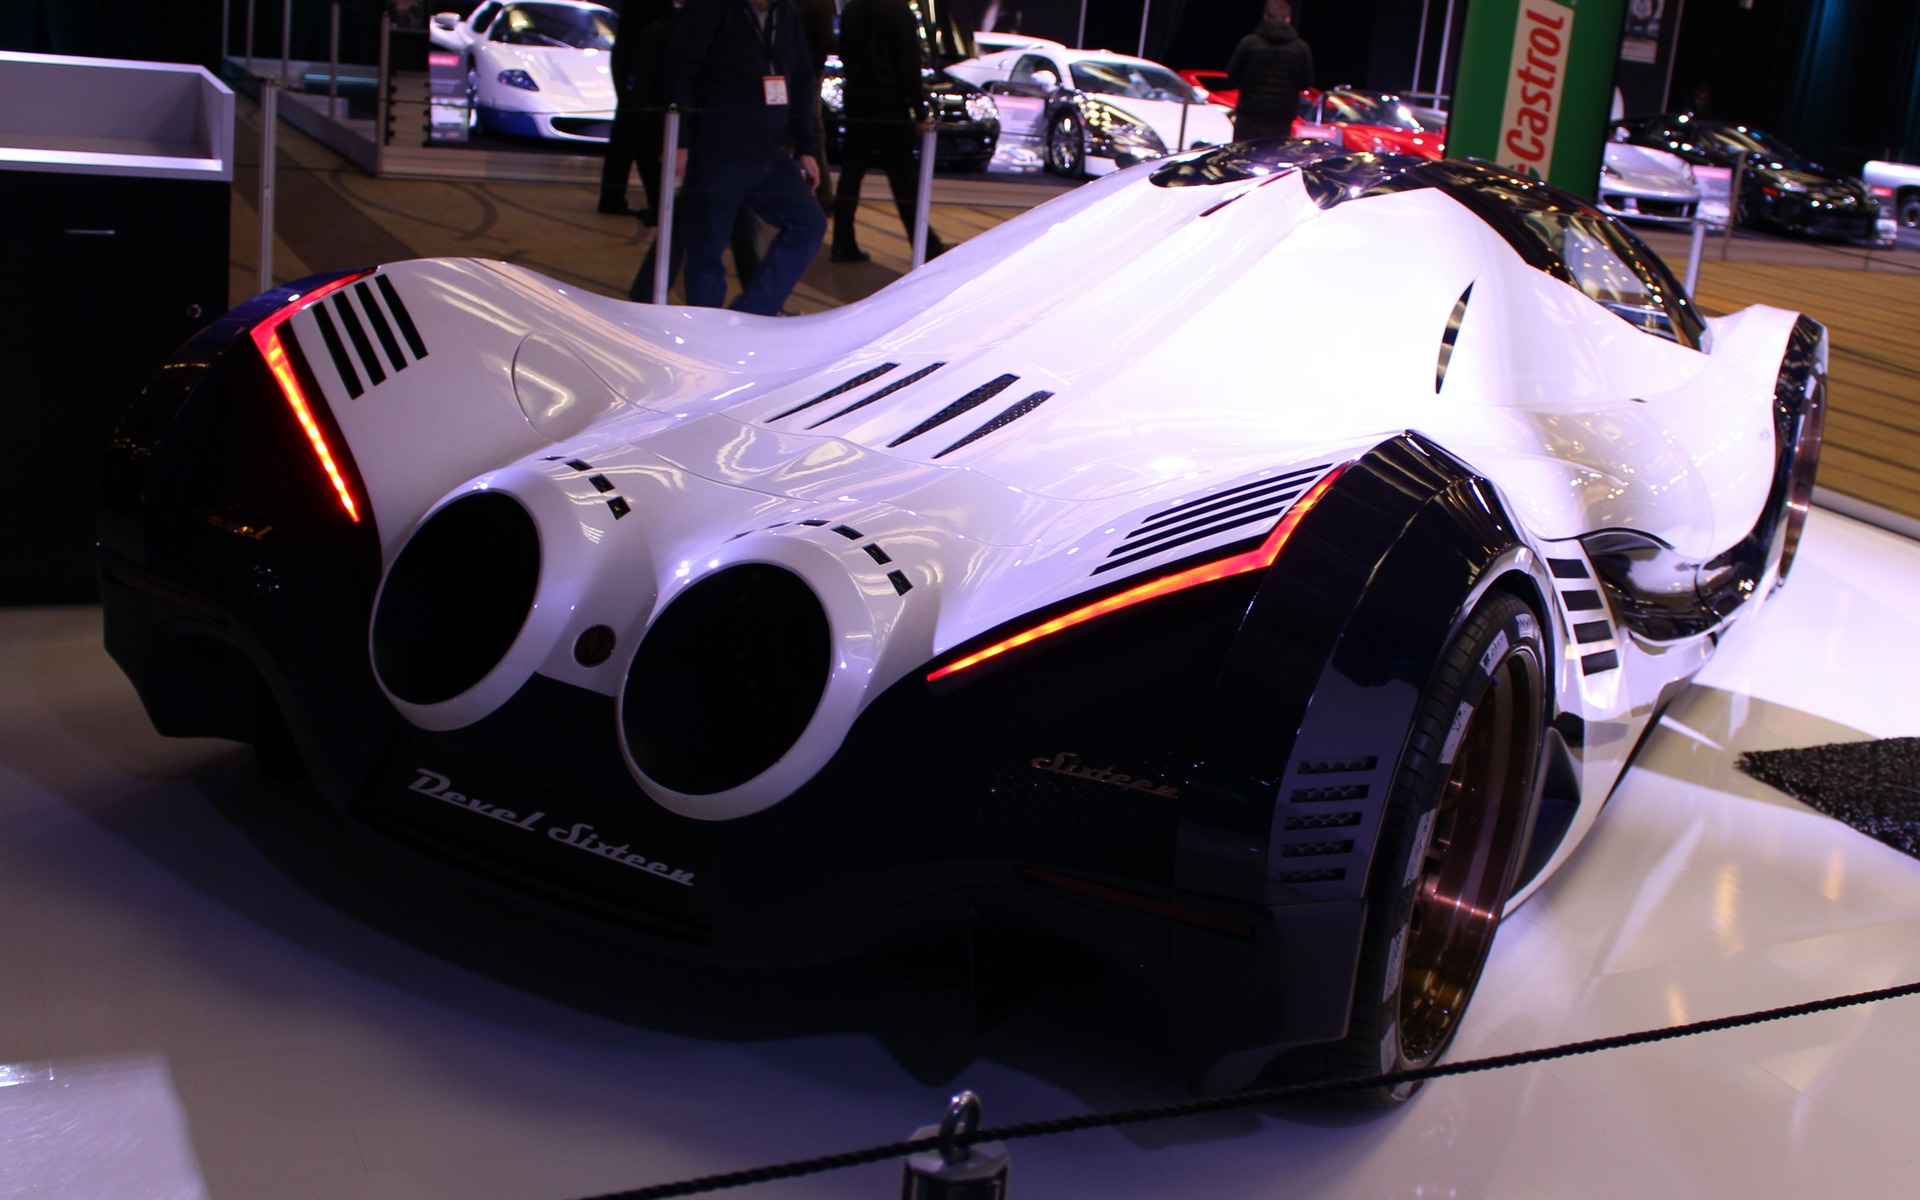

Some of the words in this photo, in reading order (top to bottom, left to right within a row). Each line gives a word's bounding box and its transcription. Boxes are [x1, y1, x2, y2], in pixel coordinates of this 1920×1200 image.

[1506, 9, 1565, 162] Castrol
[407, 767, 547, 832] Devel
[547, 822, 696, 887] Sixteen
[1030, 751, 1180, 799] Sixteen
